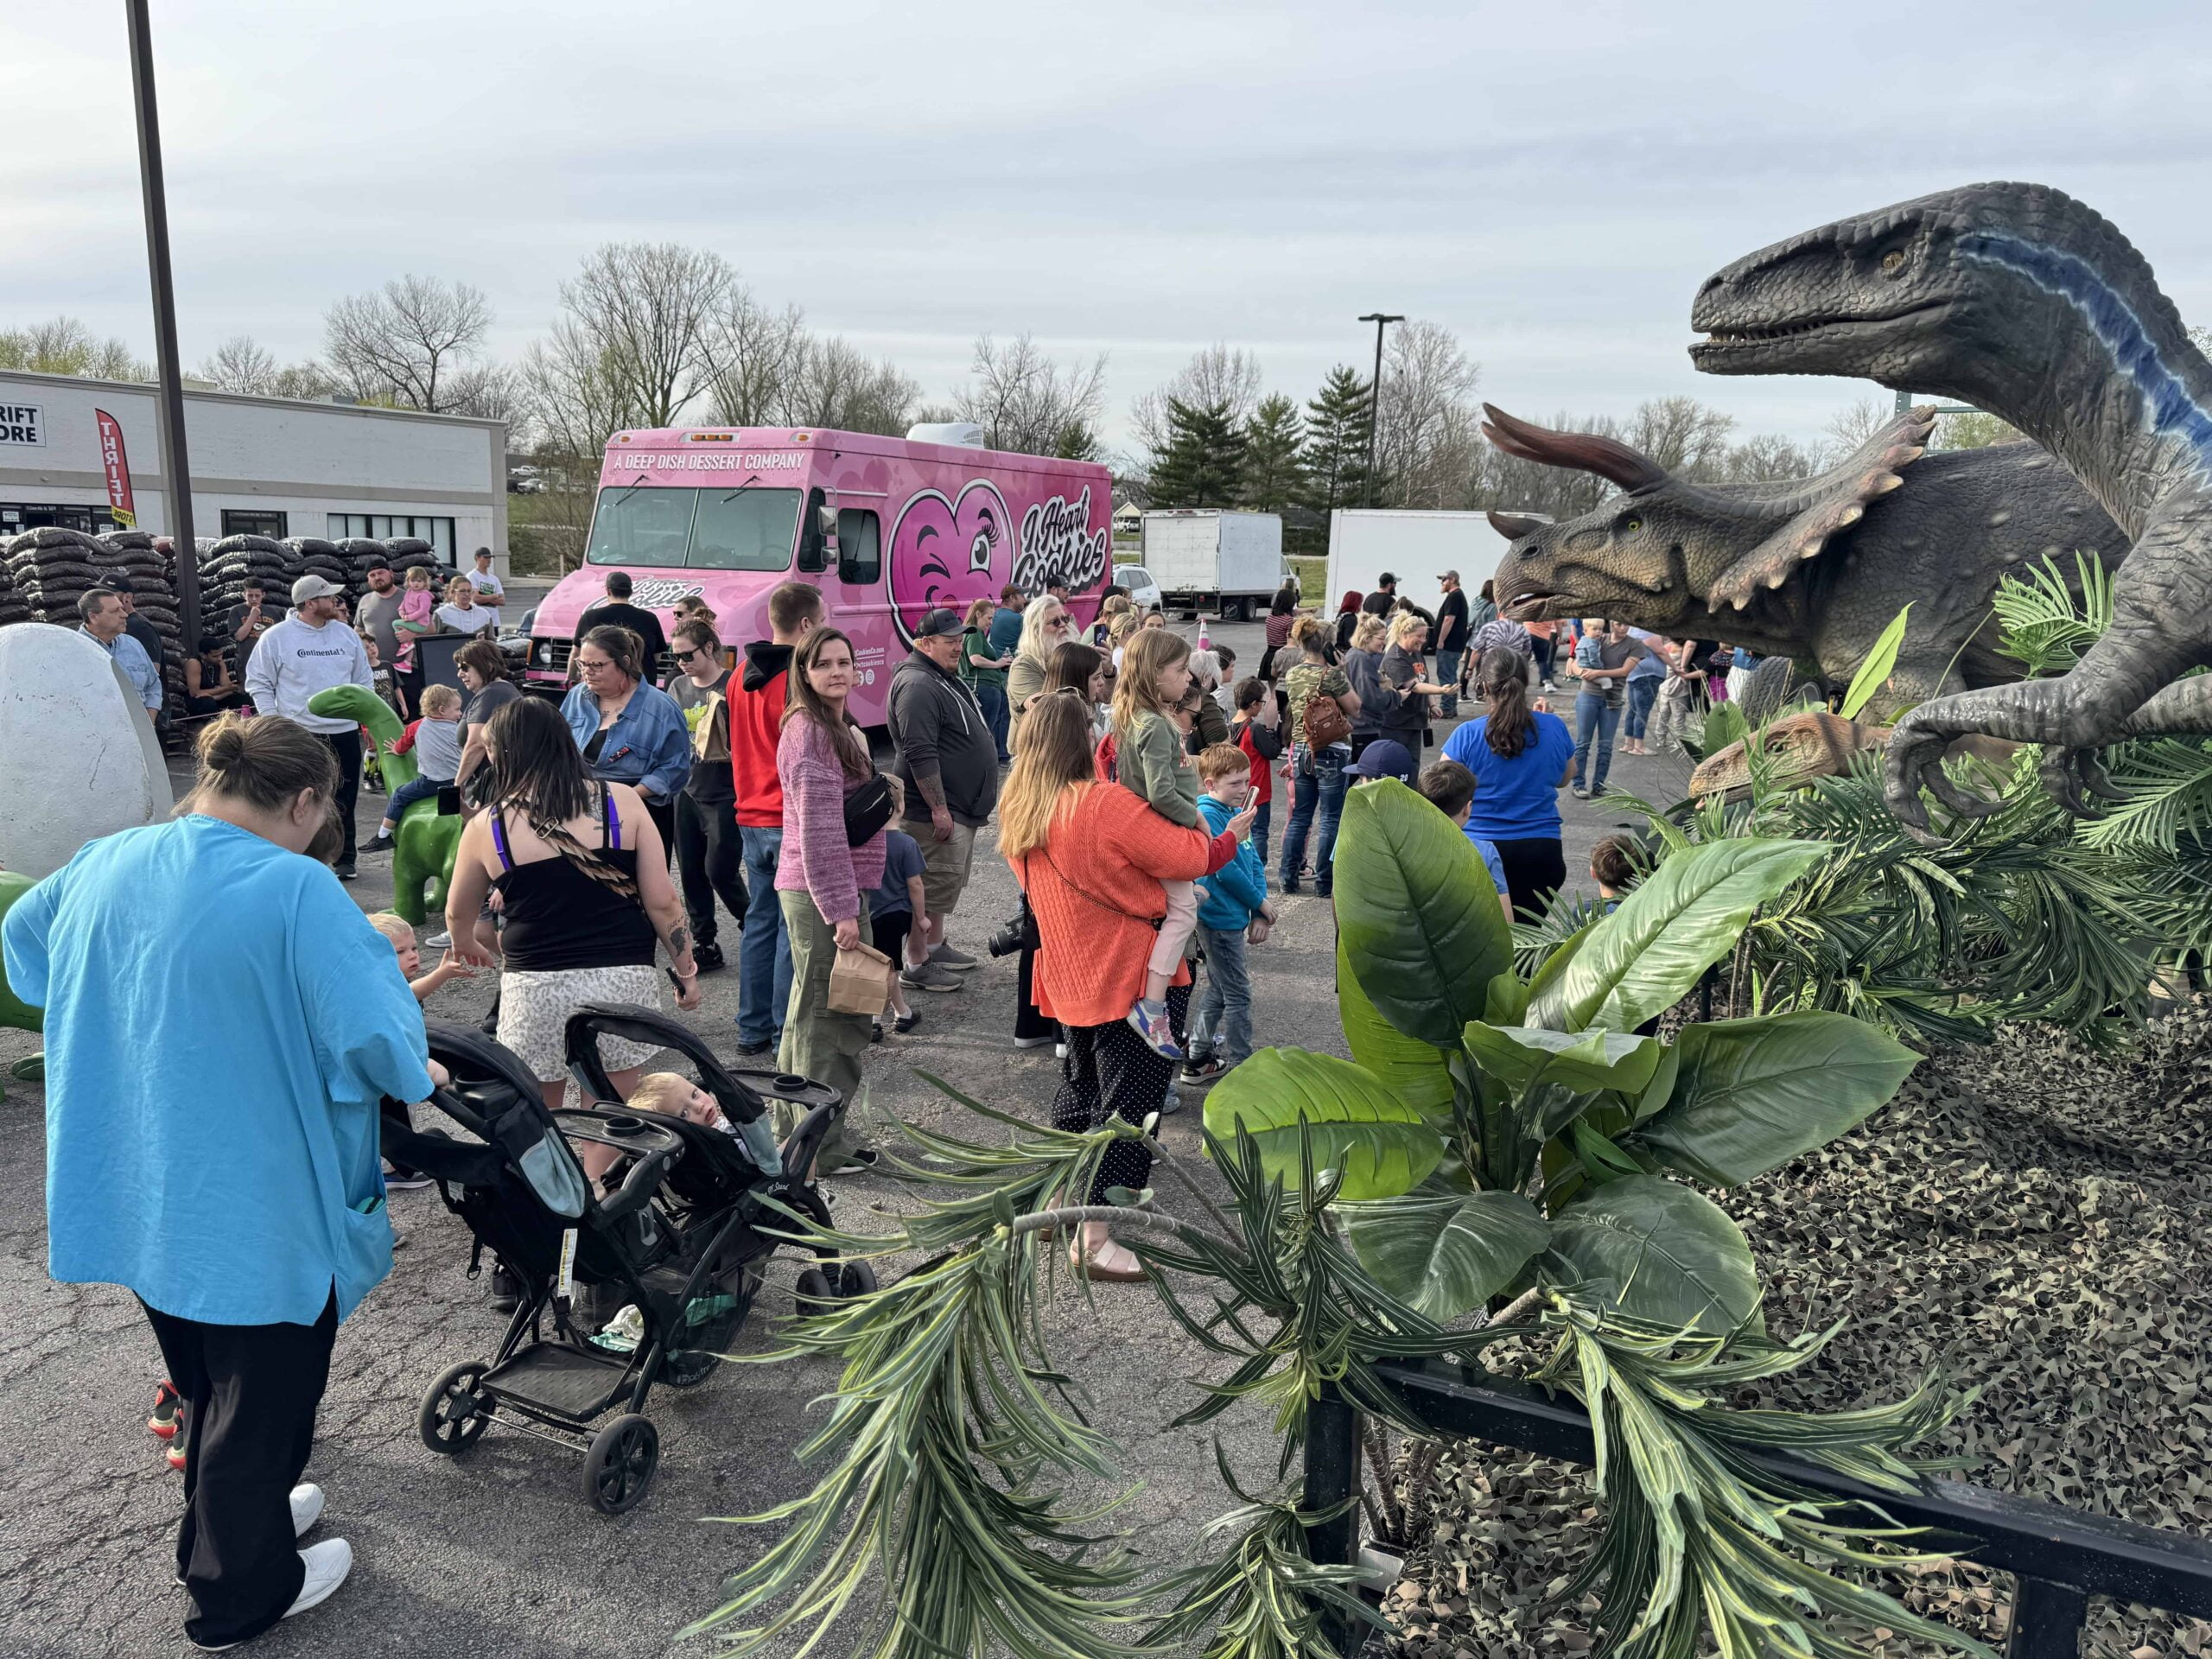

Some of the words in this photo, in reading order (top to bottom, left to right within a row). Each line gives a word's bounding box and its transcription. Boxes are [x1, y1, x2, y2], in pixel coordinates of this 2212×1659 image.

[613, 454, 622, 469] A
[625, 454, 655, 470] DEEP
[657, 454, 686, 470] DISH
[688, 454, 744, 470] DESSERT
[744, 453, 805, 470] COMPANY
[1039, 486, 1089, 555] Heart
[1013, 531, 1106, 594] Cookies
[296, 648, 340, 658] Continental
